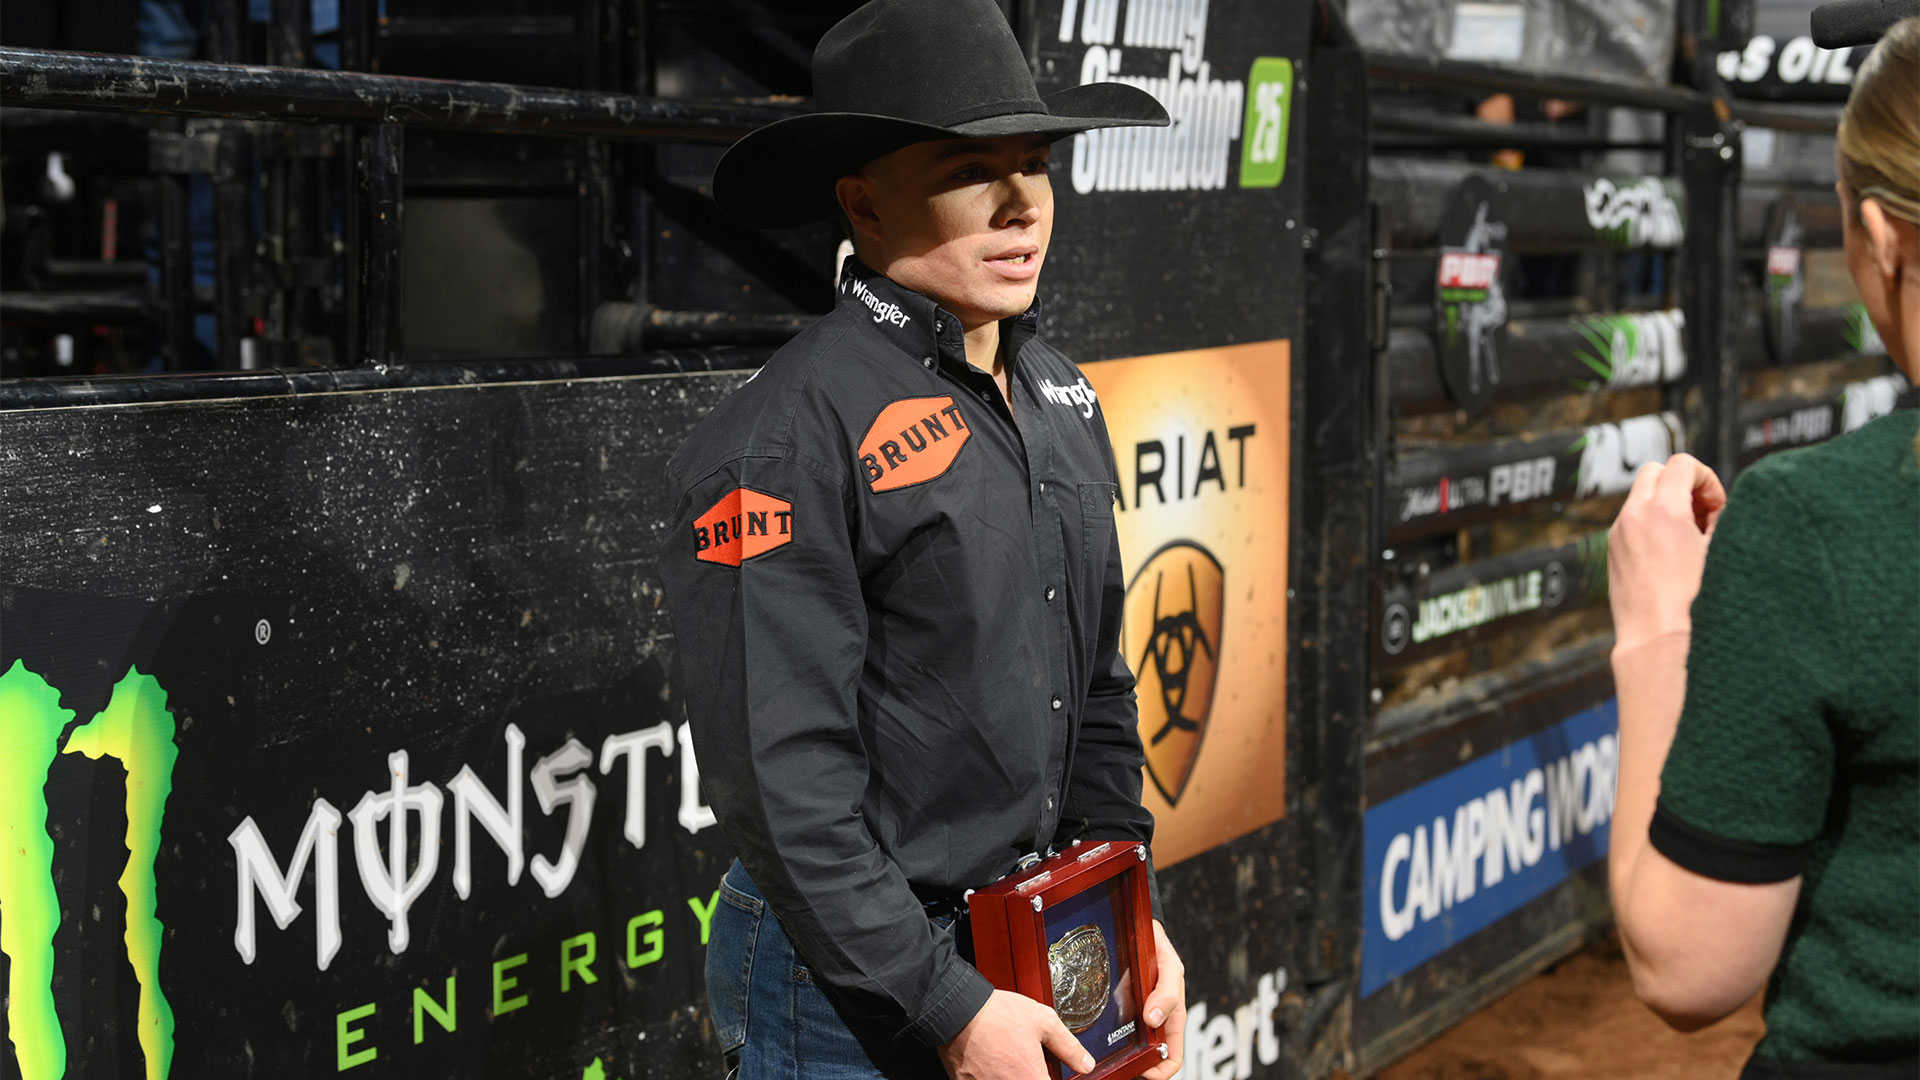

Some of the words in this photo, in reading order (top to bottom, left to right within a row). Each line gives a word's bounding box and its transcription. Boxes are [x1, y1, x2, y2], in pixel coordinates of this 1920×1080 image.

[1777, 35, 1853, 84] OIL
[1249, 81, 1284, 164] 25
[1439, 253, 1499, 287] PBR
[852, 278, 911, 329] Wrangler
[858, 402, 965, 485] BRUNT
[1489, 455, 1556, 506] PBR
[694, 510, 793, 552] BRUNT
[1412, 570, 1543, 643] JACKSONVILLE
[1380, 767, 1545, 941] CAMPING
[1546, 733, 1620, 852] WOR
[336, 889, 720, 1072] ENERGY
